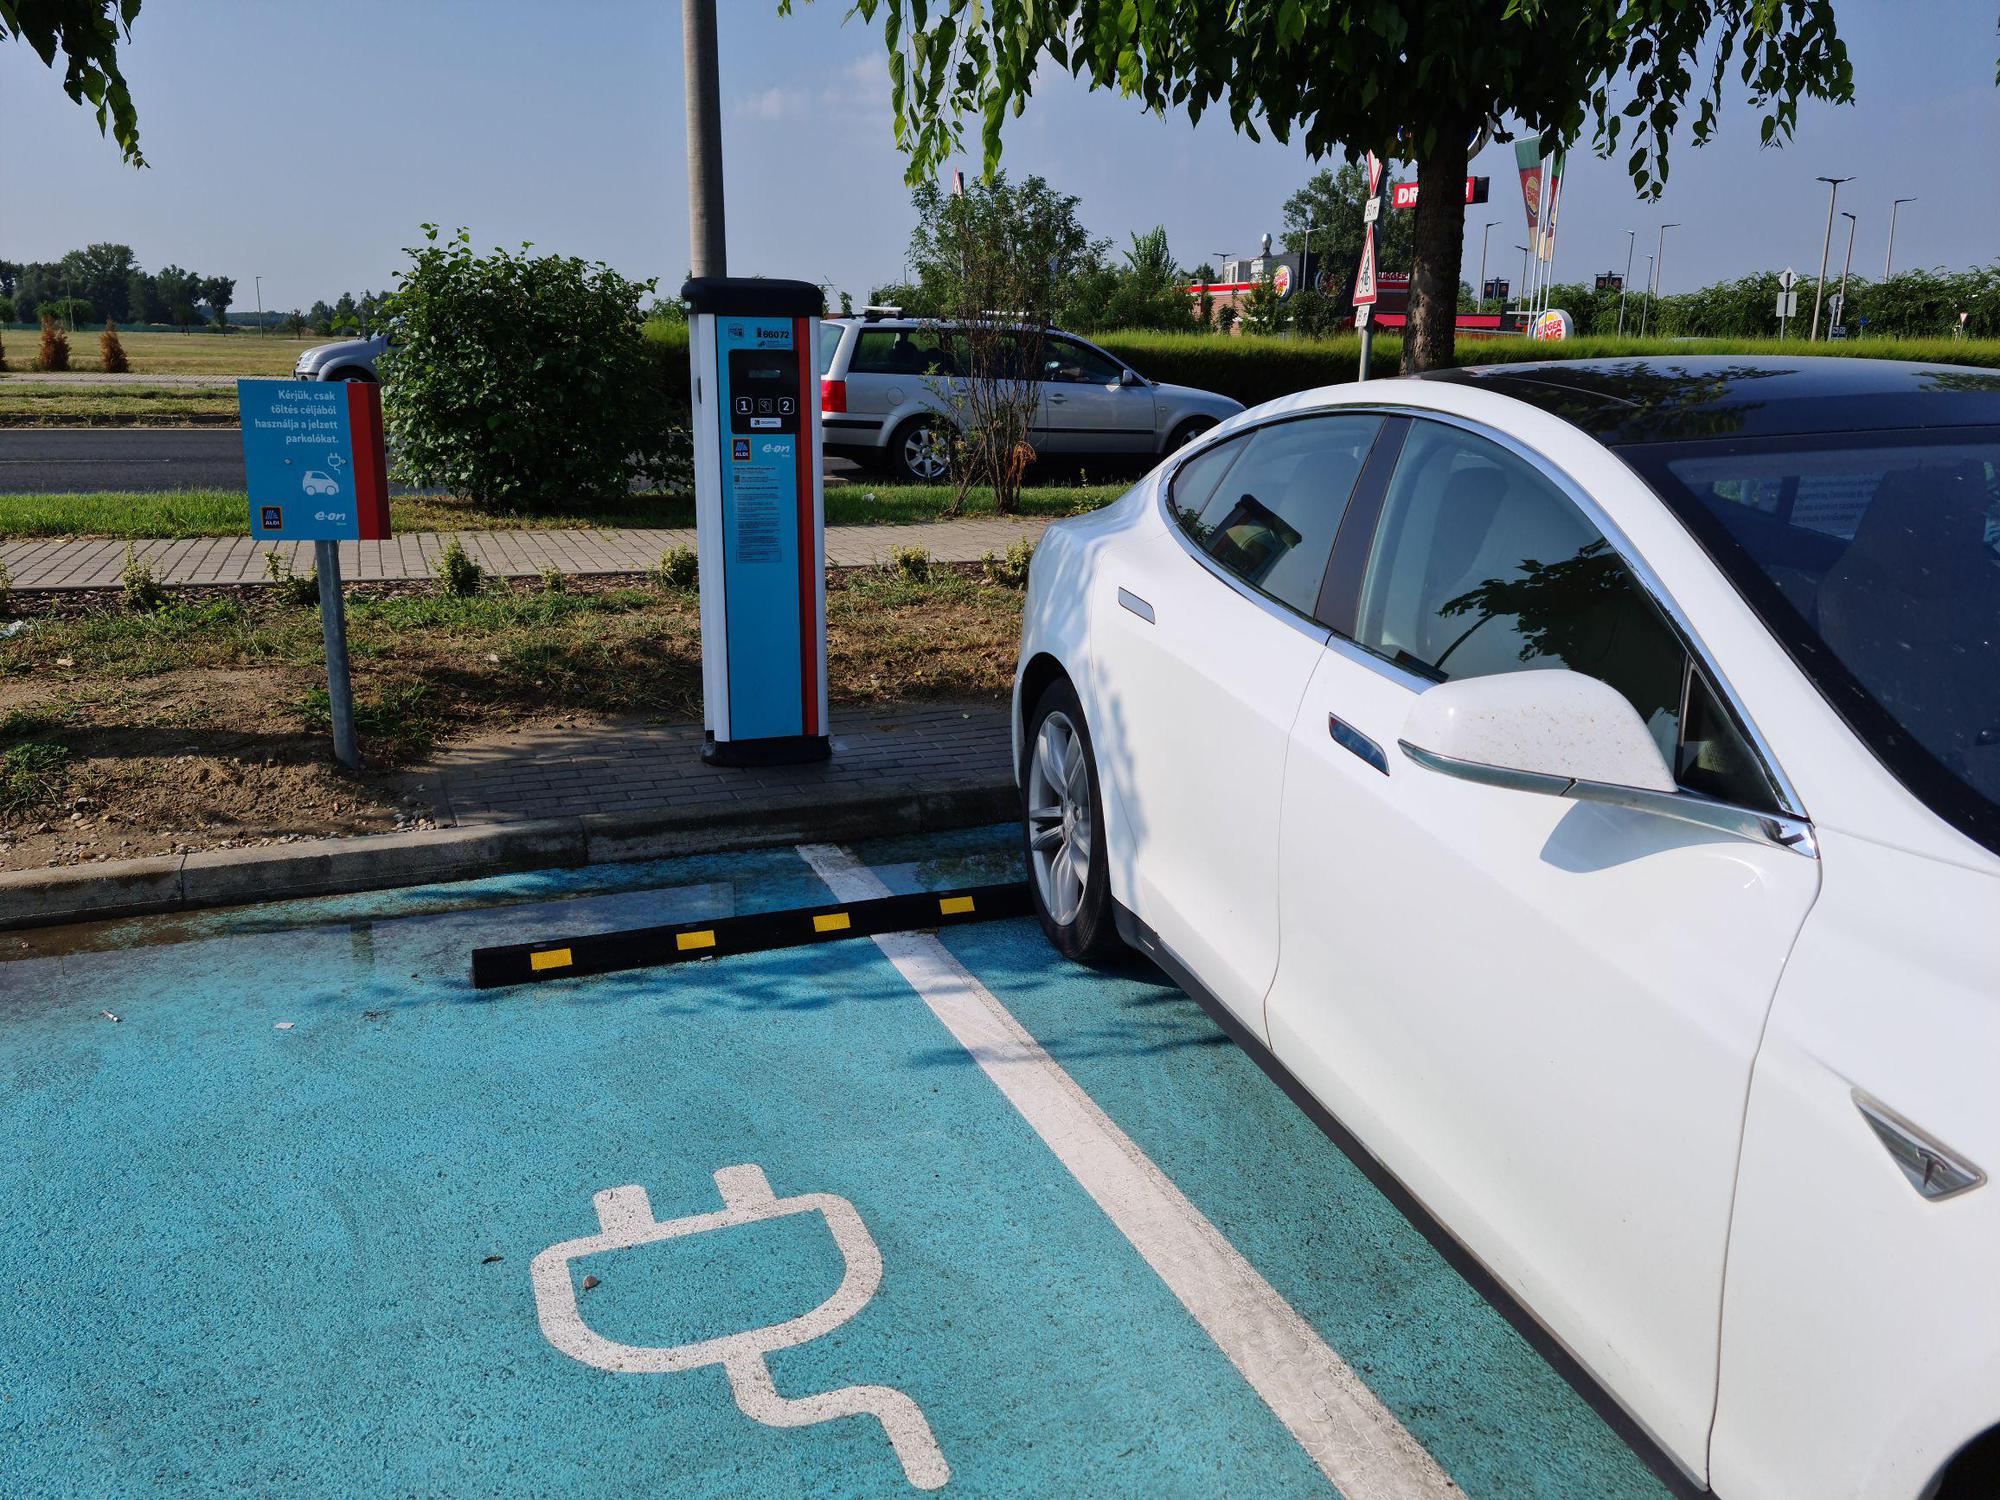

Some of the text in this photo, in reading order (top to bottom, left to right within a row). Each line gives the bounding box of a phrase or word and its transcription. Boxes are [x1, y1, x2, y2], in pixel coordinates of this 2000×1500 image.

[278, 390, 336, 402] Kérjük, csak
[270, 404, 337, 416] töltés céljából
[741, 401, 748, 411] 1
[783, 401, 790, 411] 2
[254, 418, 299, 430] használja
[308, 418, 338, 431] jelzett
[285, 433, 339, 445] parkolókat.
